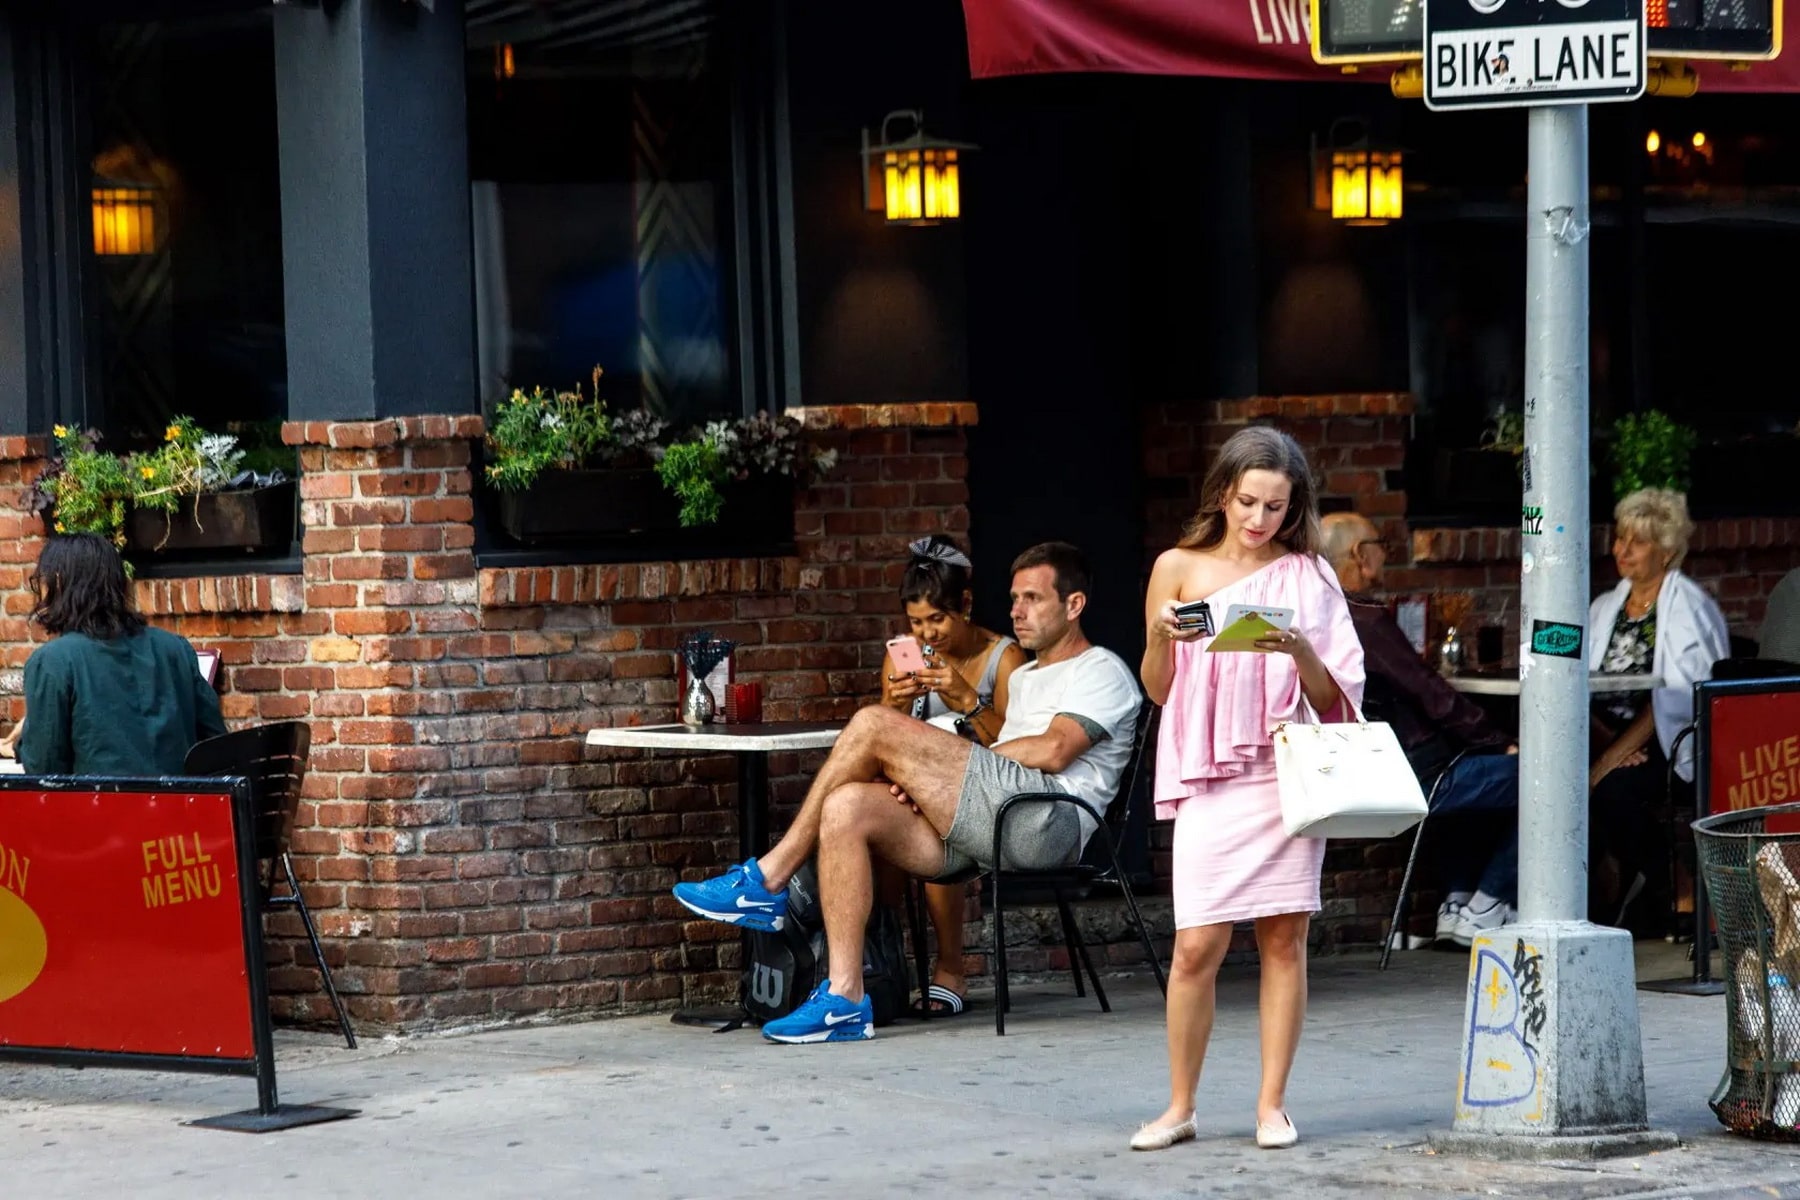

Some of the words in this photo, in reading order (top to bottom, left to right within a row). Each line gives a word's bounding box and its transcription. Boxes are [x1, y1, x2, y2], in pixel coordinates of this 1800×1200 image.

[1534, 33, 1631, 83] LANE
[1740, 735, 1800, 780] LIVE
[1728, 767, 1800, 811] MUSI
[142, 832, 211, 873] FULL
[141, 864, 222, 908] MENU
